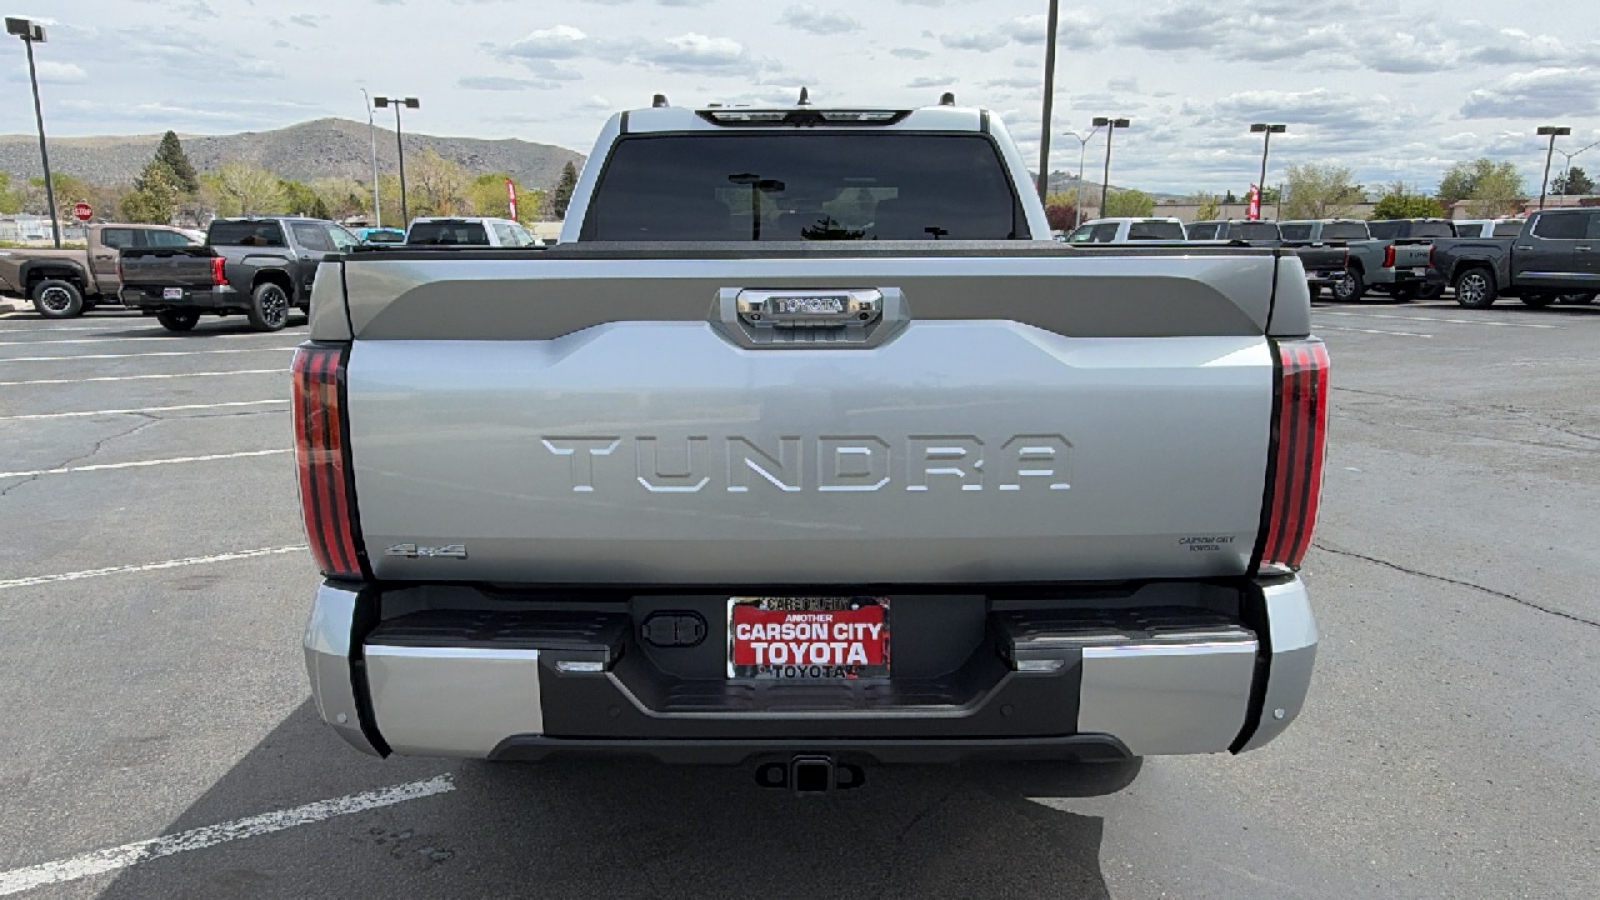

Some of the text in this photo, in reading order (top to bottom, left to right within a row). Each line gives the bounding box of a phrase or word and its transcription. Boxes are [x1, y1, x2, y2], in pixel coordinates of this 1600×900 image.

[74, 208, 92, 216] STOP
[777, 298, 844, 312] TOYOTA
[541, 434, 1074, 492] TUNDRA
[785, 614, 833, 622] ANOTHER
[736, 623, 883, 641] CARSON CITY
[750, 642, 869, 665] TOYOTA
[773, 665, 846, 678] TOYOTA
